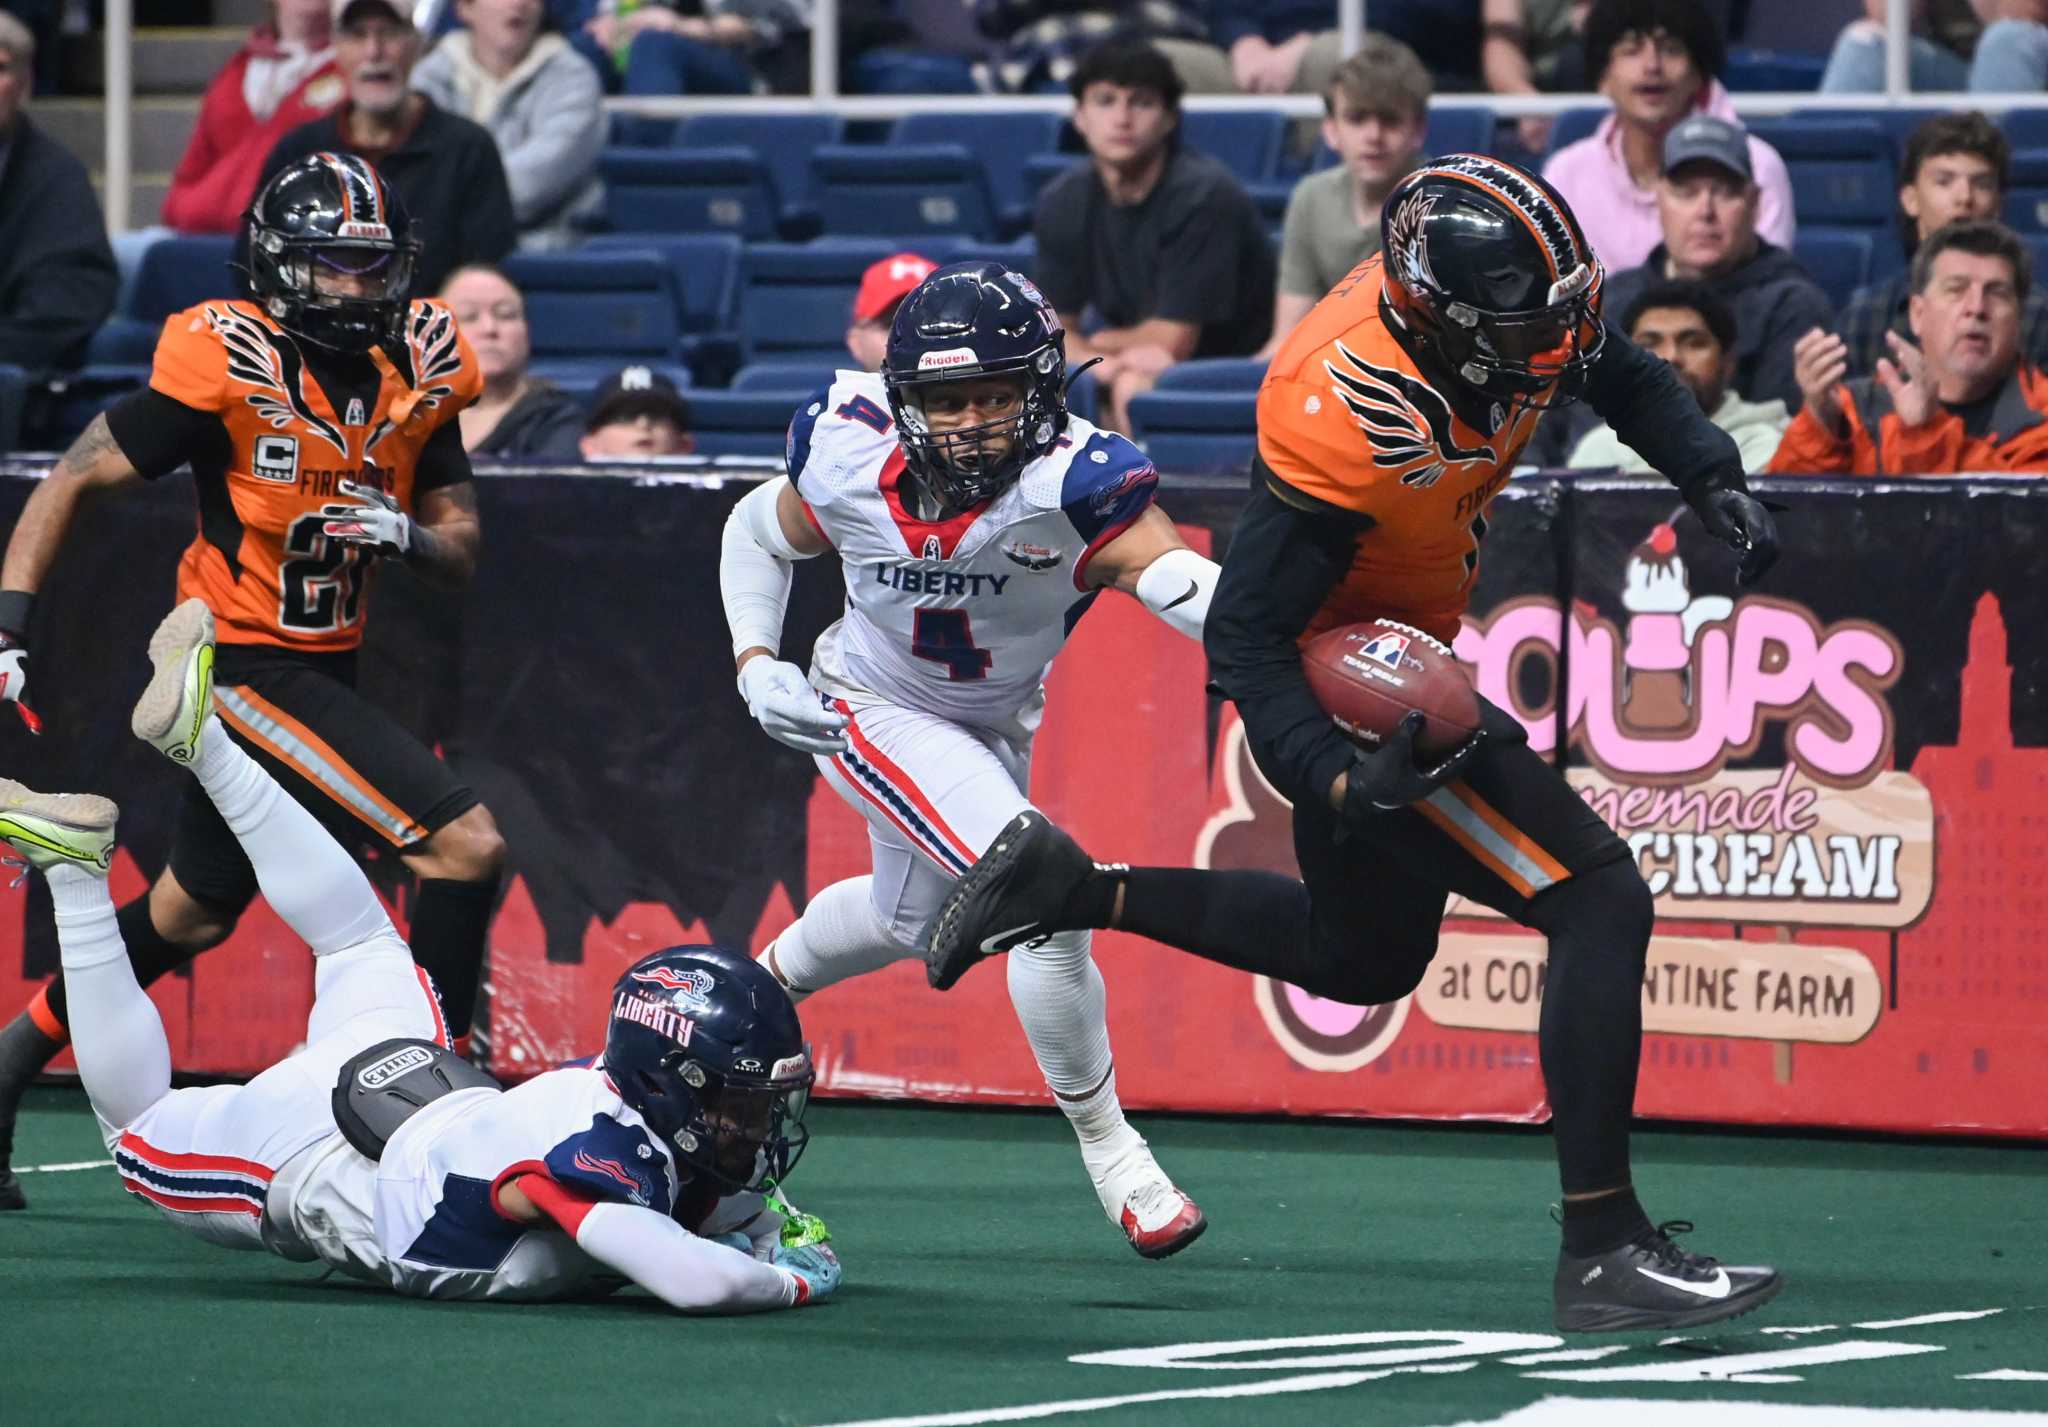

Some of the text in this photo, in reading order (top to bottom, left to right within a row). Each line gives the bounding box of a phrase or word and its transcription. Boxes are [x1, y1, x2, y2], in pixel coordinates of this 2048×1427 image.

[834, 394, 896, 436] 4
[256, 438, 296, 471] C
[877, 563, 1010, 596] LIBERTY
[912, 606, 993, 682] 4
[1453, 597, 1903, 790] OUPS
[1577, 762, 1820, 835] memade
[1626, 832, 1901, 899] CREAM
[1440, 965, 1471, 1000] at
[1755, 969, 1855, 1017] FARM
[614, 991, 695, 1048] LIBERTY
[363, 1049, 428, 1085] BATTLE
